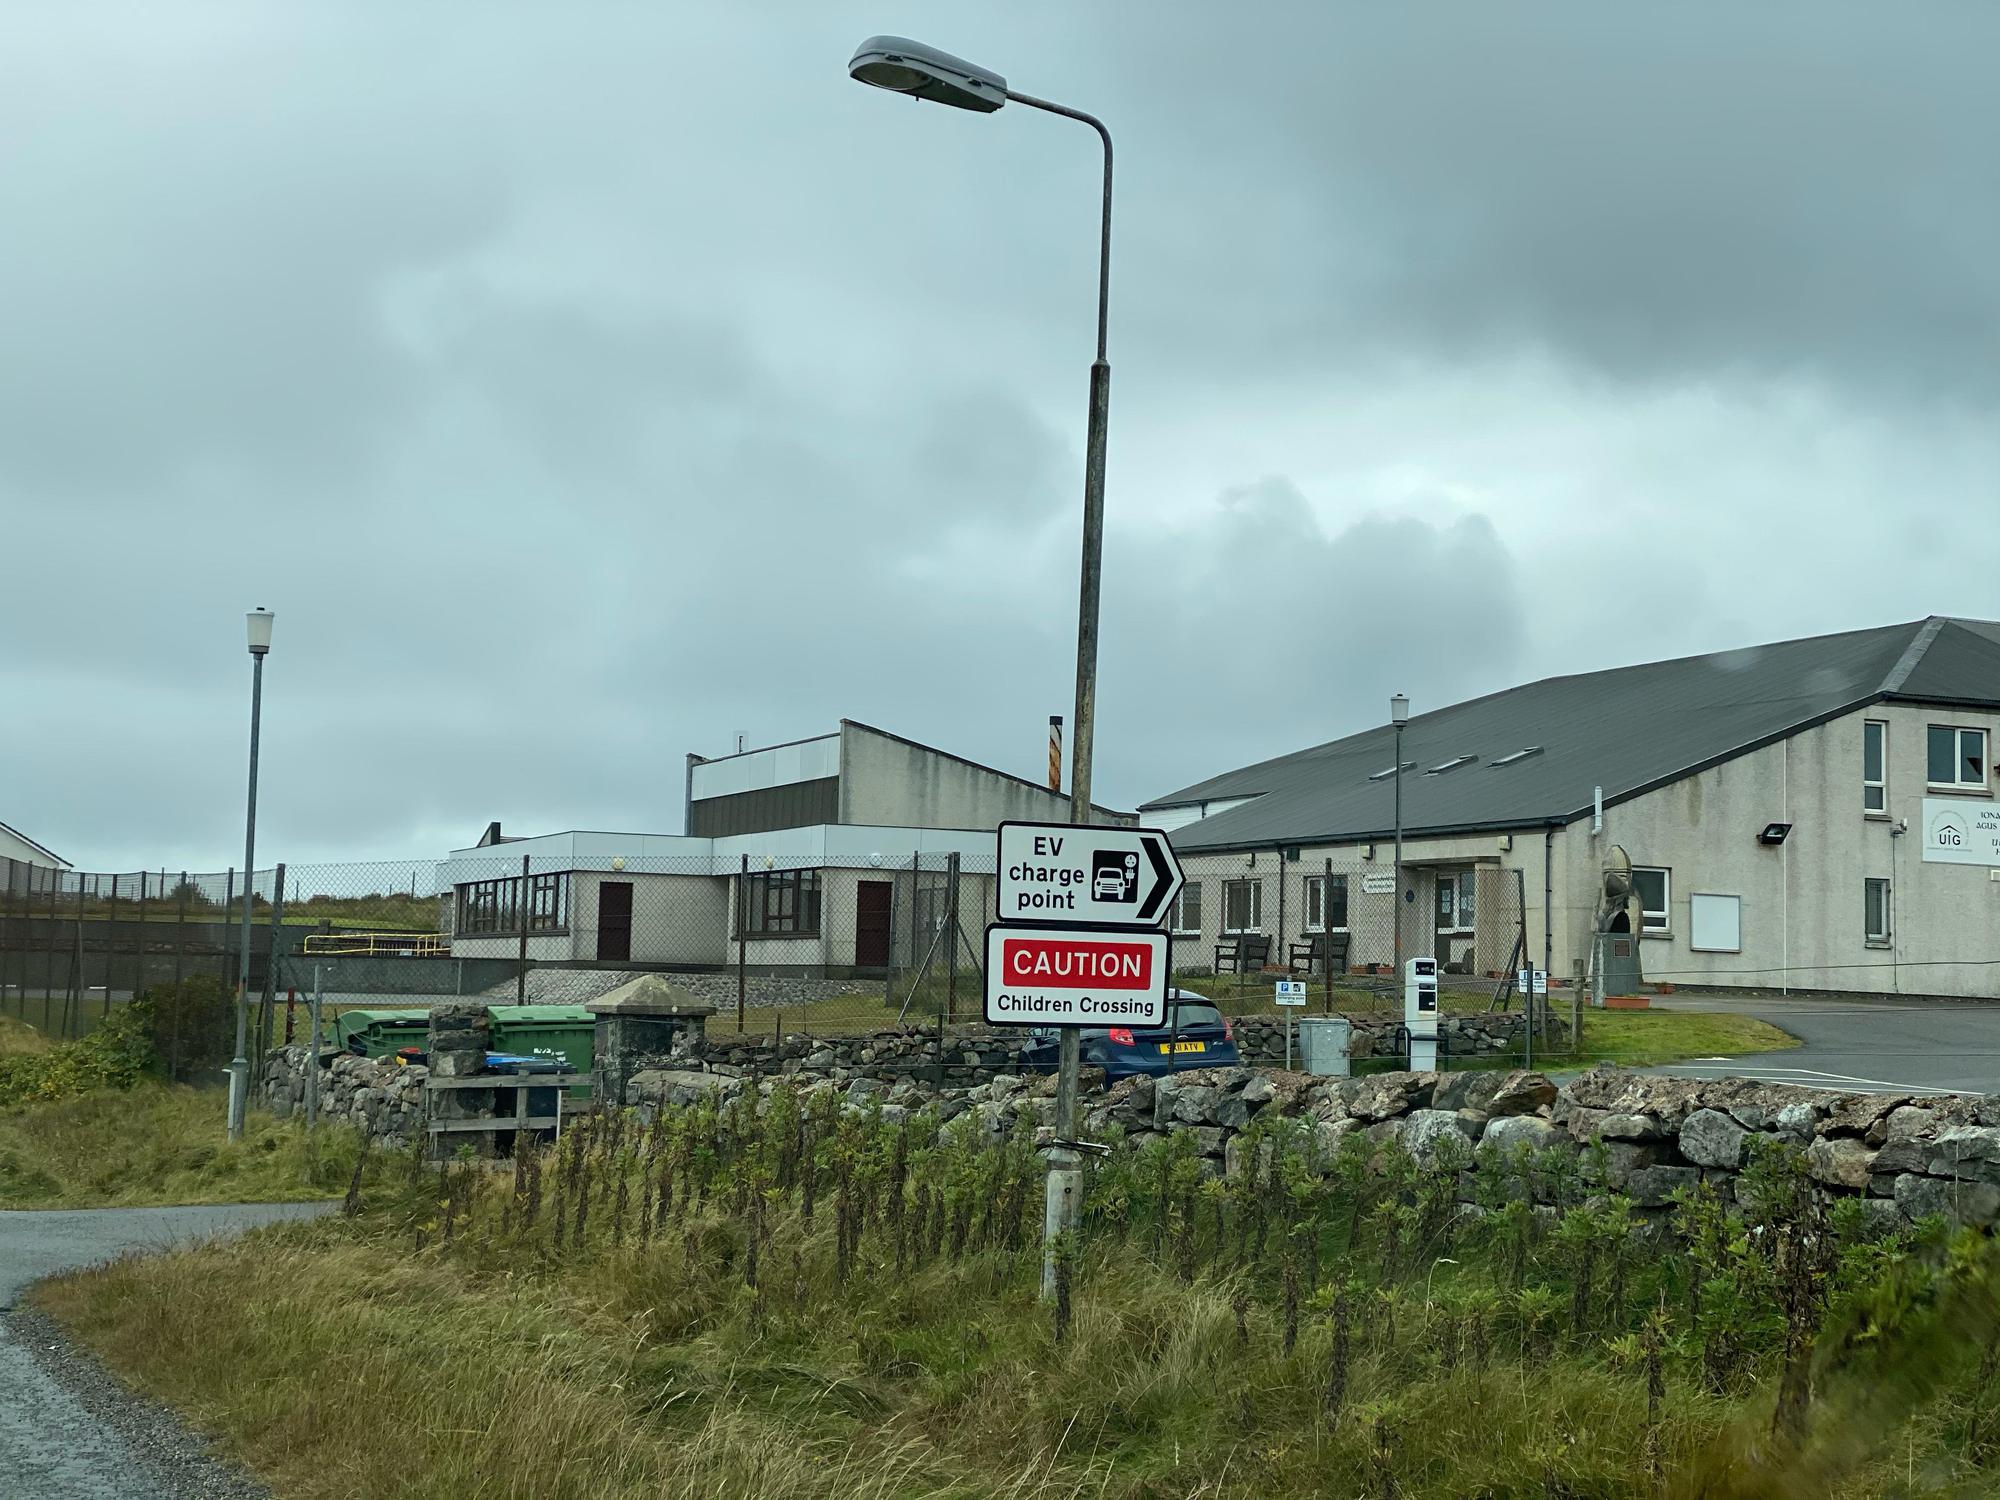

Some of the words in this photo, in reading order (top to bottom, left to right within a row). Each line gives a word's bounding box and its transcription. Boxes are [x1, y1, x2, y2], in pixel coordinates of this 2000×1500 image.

[1976, 822, 1998, 830] AGUS
[1034, 836, 1064, 857] EV
[1992, 838, 2000, 847] U
[1009, 862, 1085, 886] charge
[1017, 889, 1075, 910] point
[1013, 949, 1141, 978] CAUTION
[997, 994, 1073, 1012] Children
[1079, 996, 1154, 1017] Crossing
[1184, 1043, 1198, 1051] ATV
